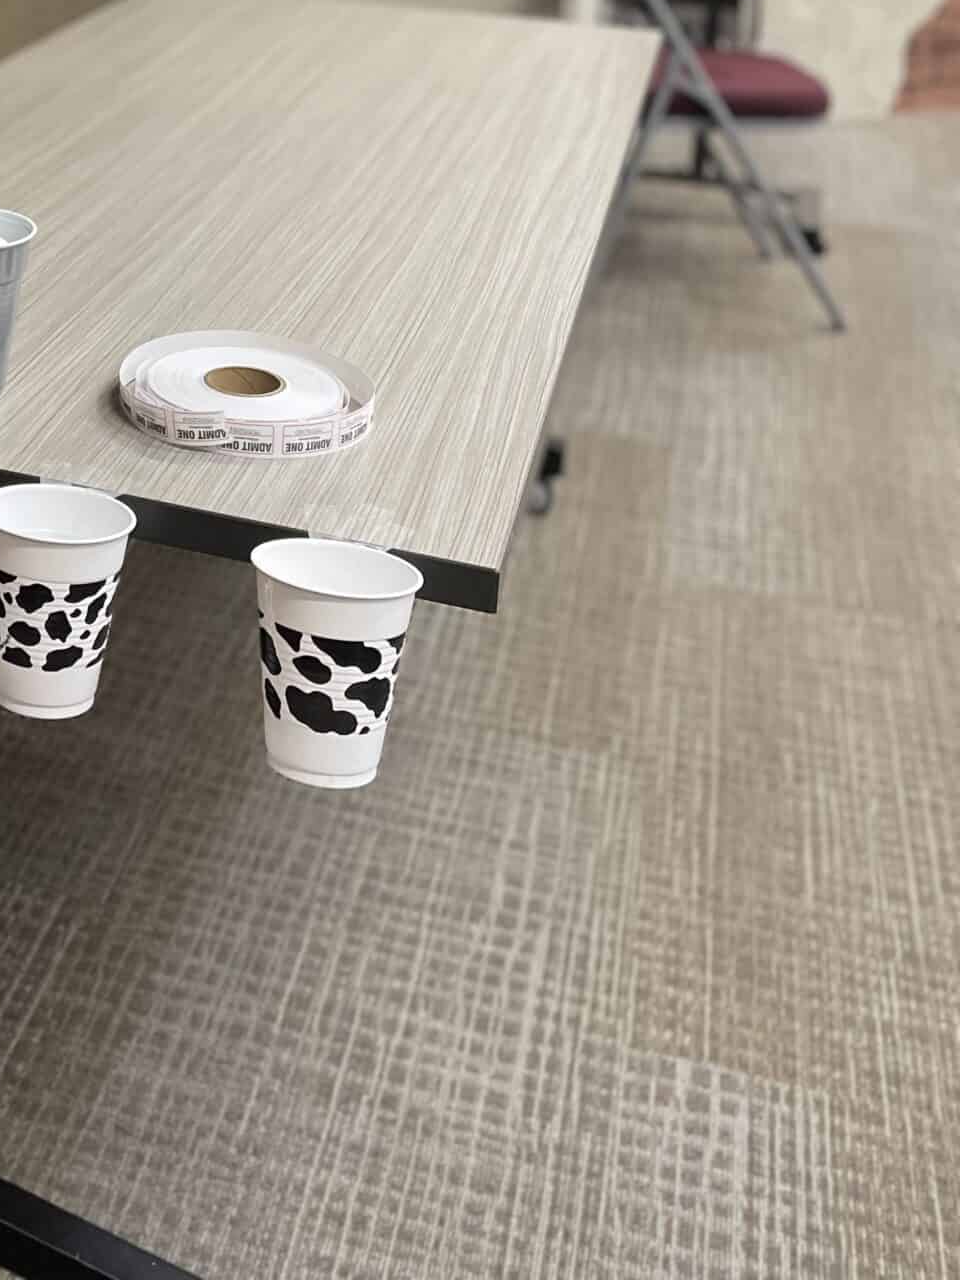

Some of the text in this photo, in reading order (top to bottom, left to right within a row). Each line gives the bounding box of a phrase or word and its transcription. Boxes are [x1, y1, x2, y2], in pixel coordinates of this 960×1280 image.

[177, 429, 195, 440] ONE
[198, 429, 226, 440] ADMIT
[241, 442, 272, 453] ADMIT
[285, 439, 332, 453] ADMIT ONE
